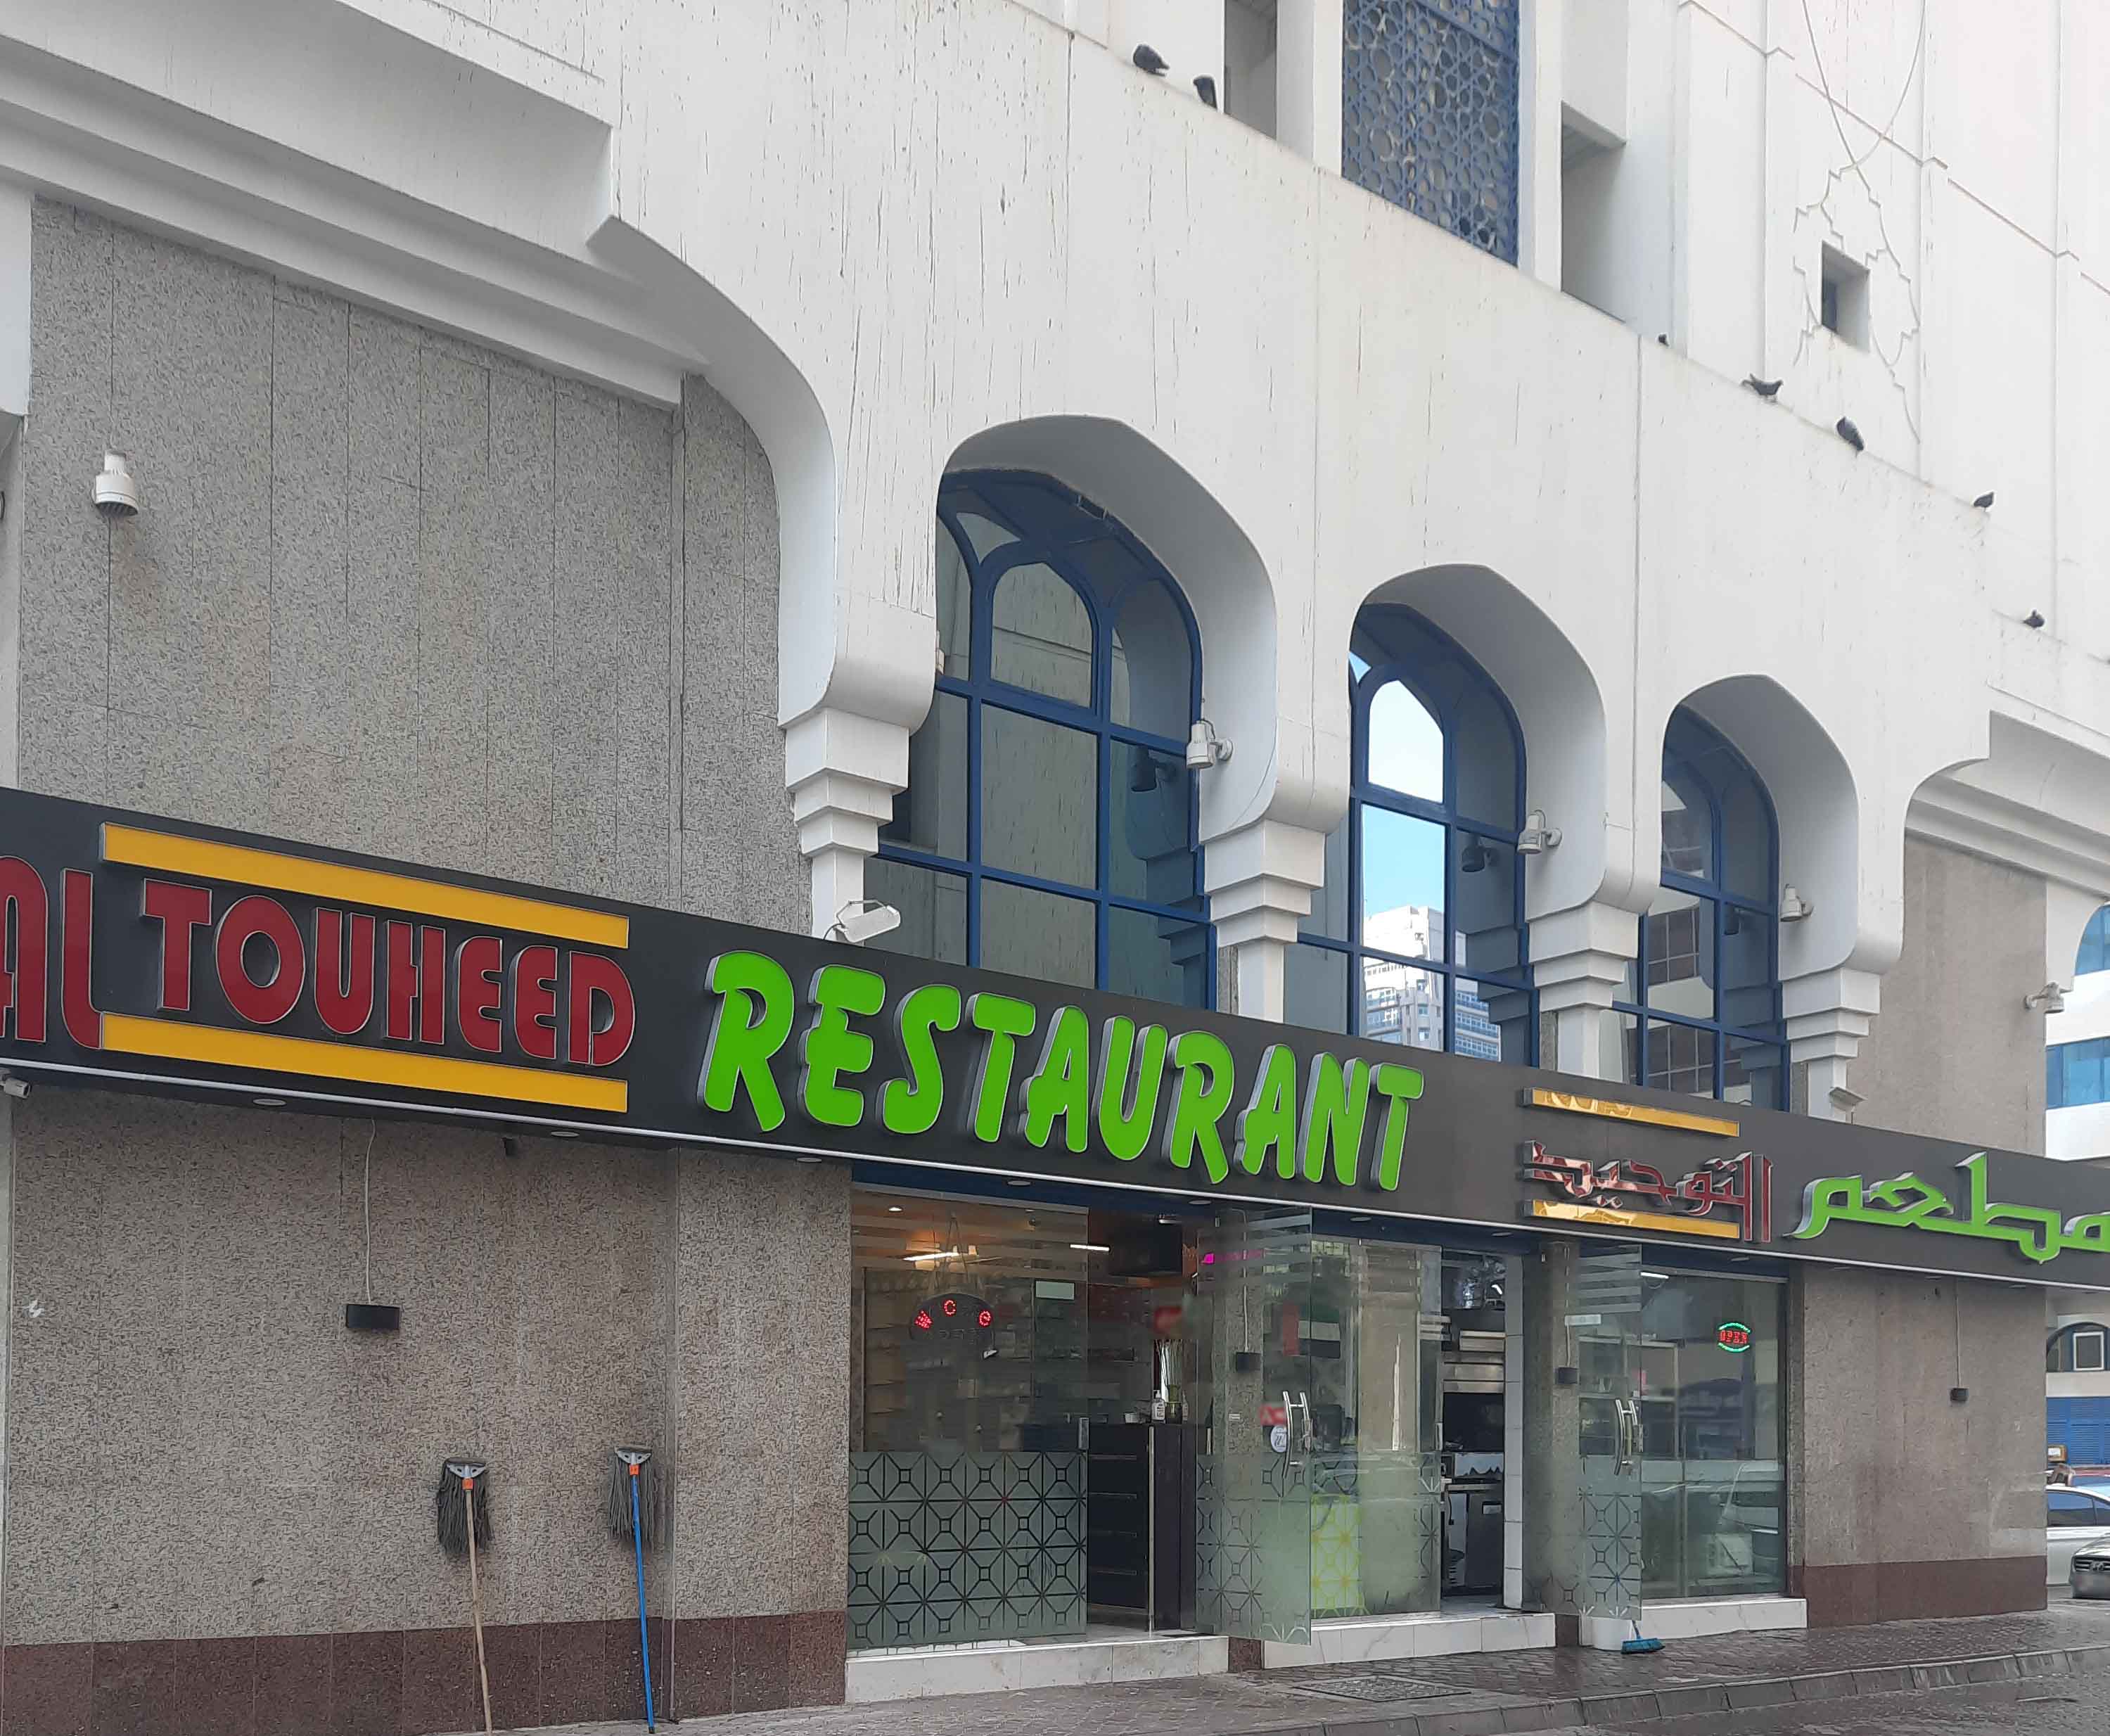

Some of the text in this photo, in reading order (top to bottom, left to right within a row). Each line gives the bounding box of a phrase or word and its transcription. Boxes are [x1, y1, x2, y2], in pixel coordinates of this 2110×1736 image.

[0, 855, 637, 1066] AL TOUHEED
[697, 950, 1424, 1191] RESTAURANT
[1523, 1140, 2110, 1265] مطعم التوحيد
